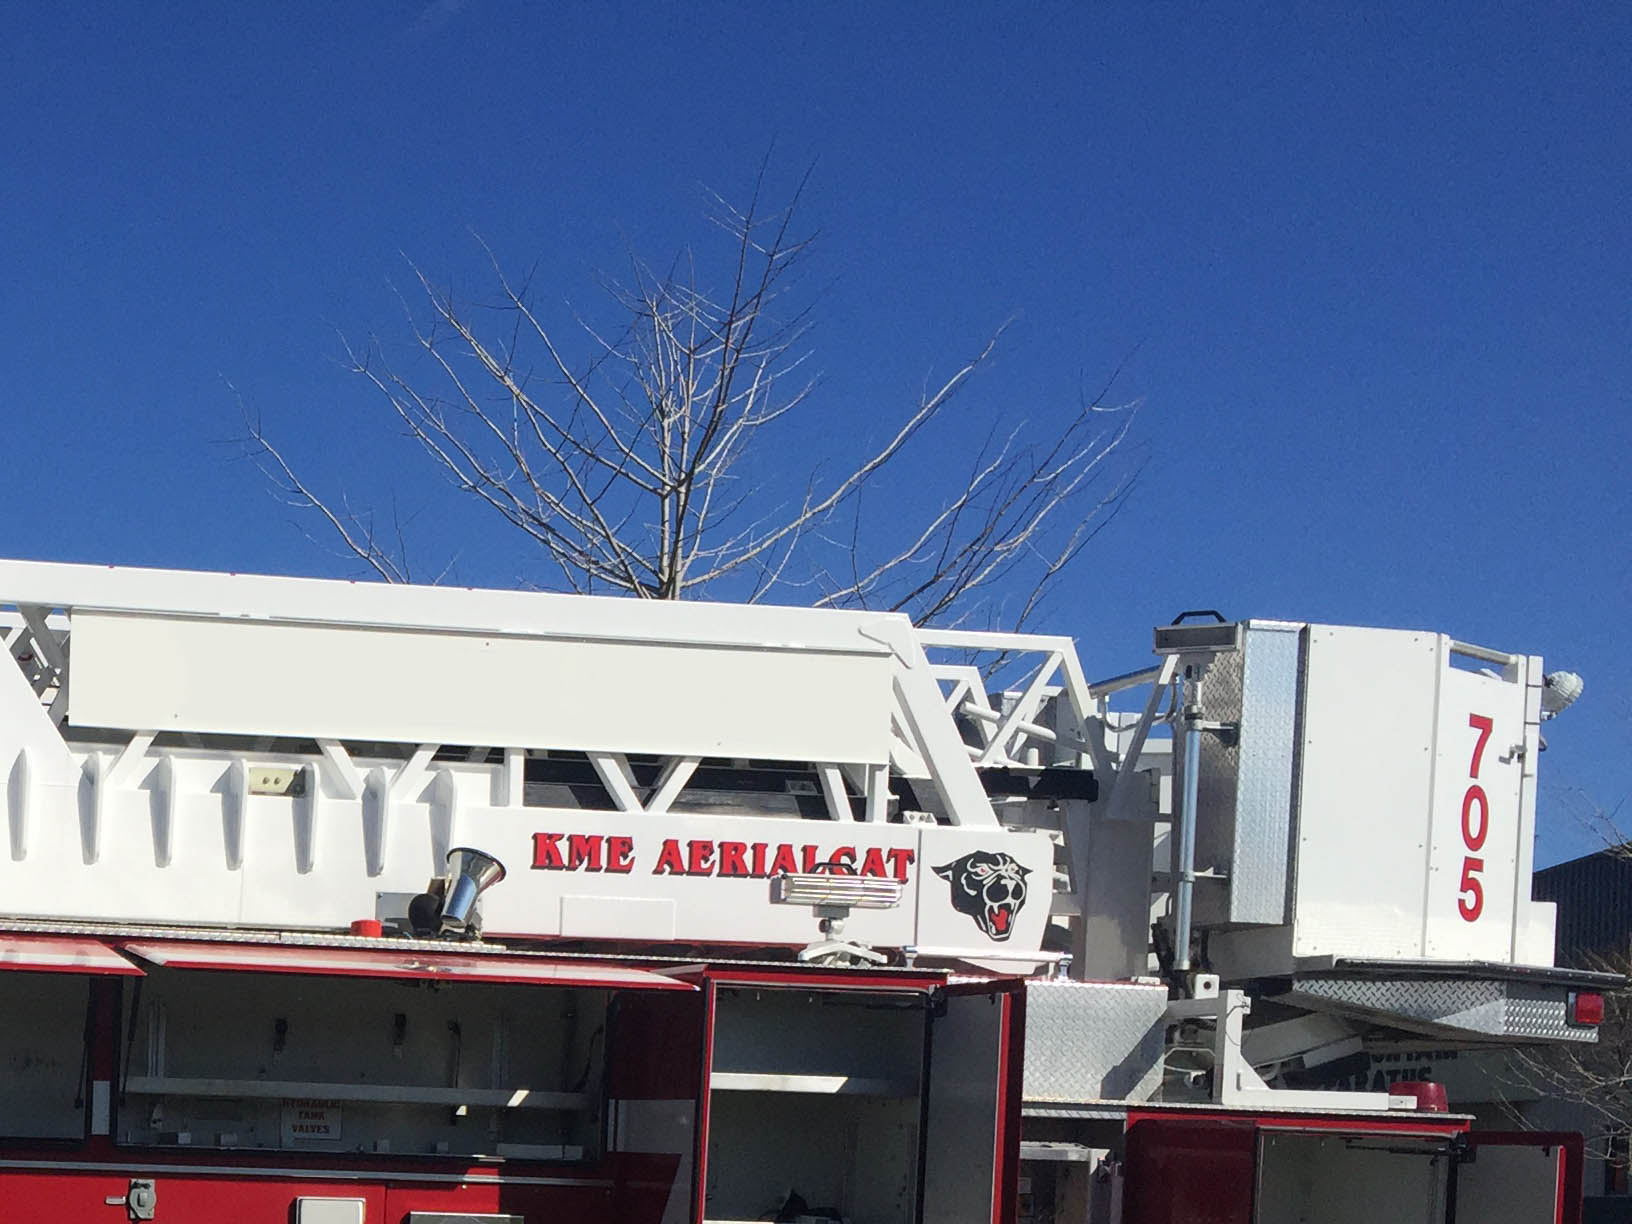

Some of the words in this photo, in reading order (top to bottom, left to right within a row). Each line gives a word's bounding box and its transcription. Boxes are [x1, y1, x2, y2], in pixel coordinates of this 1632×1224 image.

[1458, 713, 1493, 922] 705
[530, 832, 635, 873] KME
[652, 838, 915, 884] AERIALCAT
[292, 1124, 330, 1134] VALVES
[298, 1111, 325, 1121] TANK
